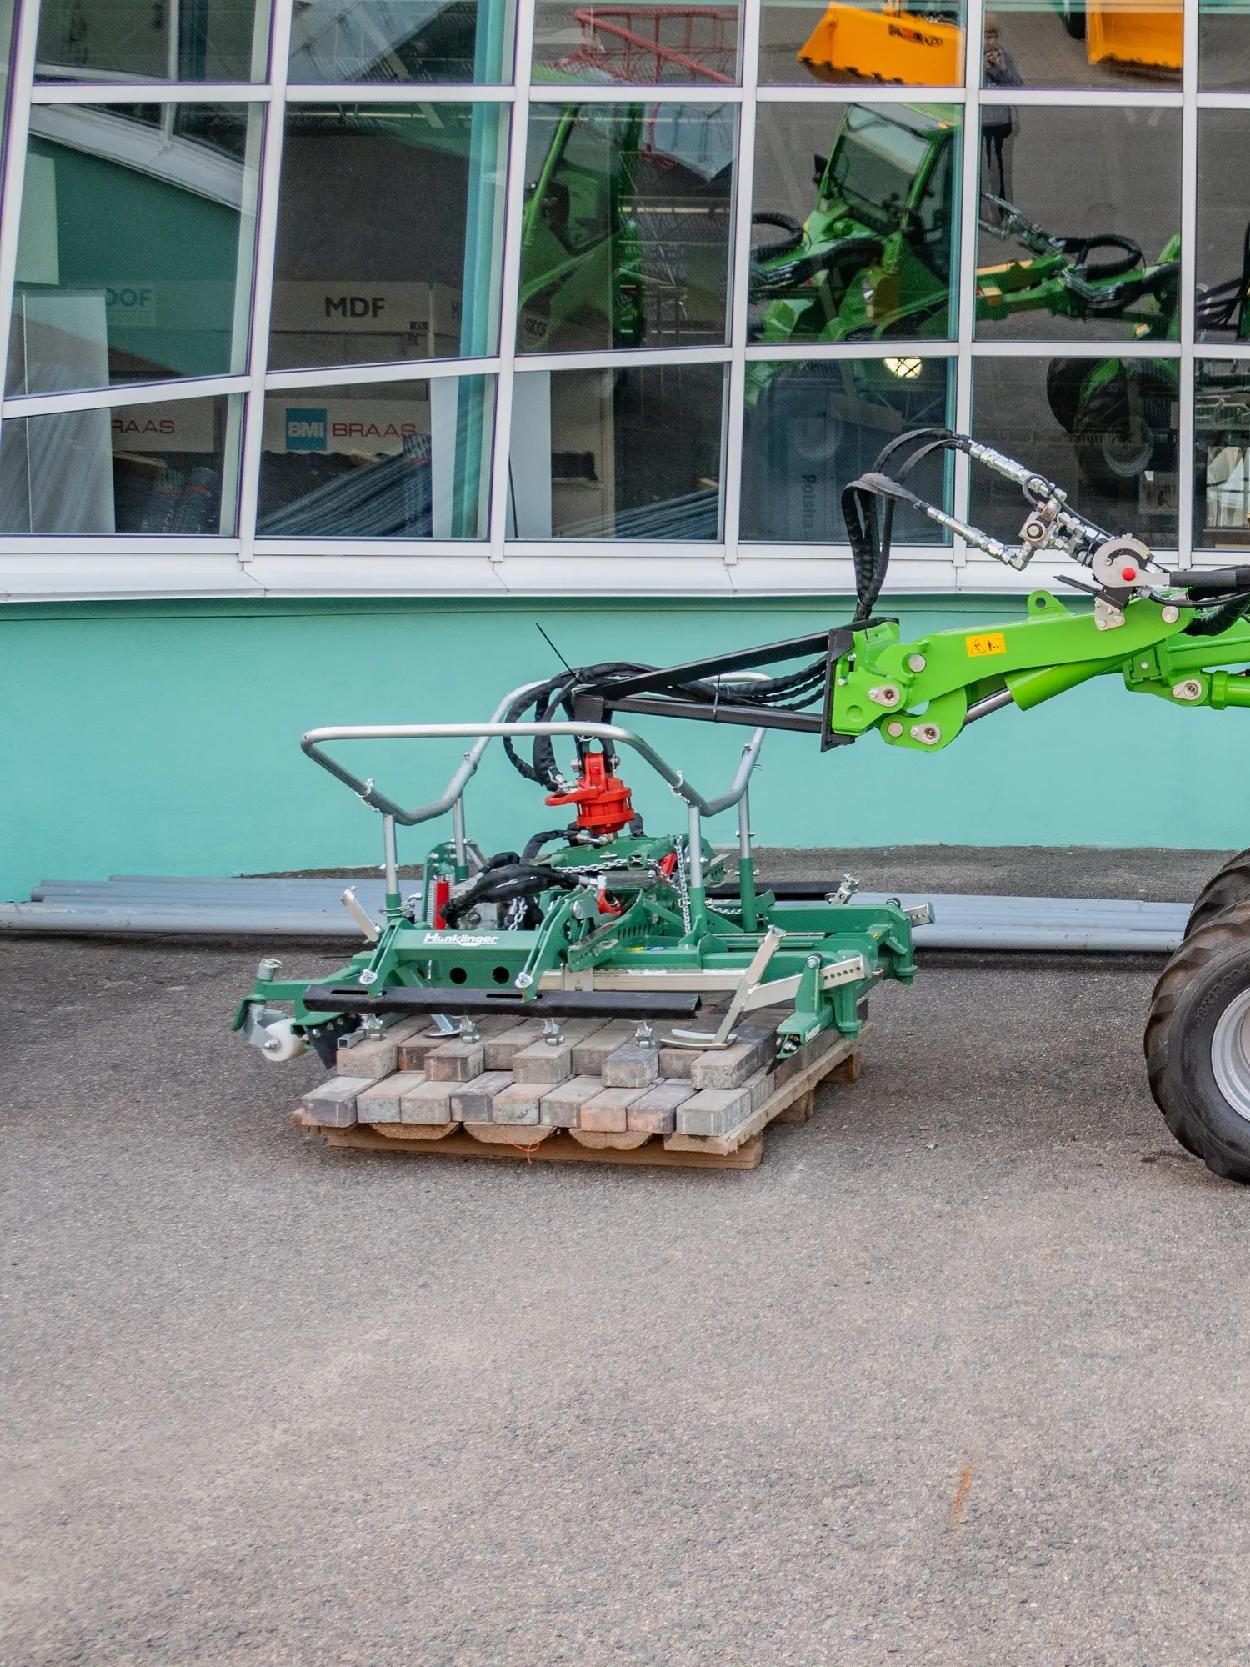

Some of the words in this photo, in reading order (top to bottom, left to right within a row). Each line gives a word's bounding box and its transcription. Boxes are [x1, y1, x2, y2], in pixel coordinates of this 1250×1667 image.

[325, 297, 384, 317] MDF
[112, 420, 175, 434] RAAS
[287, 421, 325, 438] BMI
[332, 423, 416, 437] BRAAS
